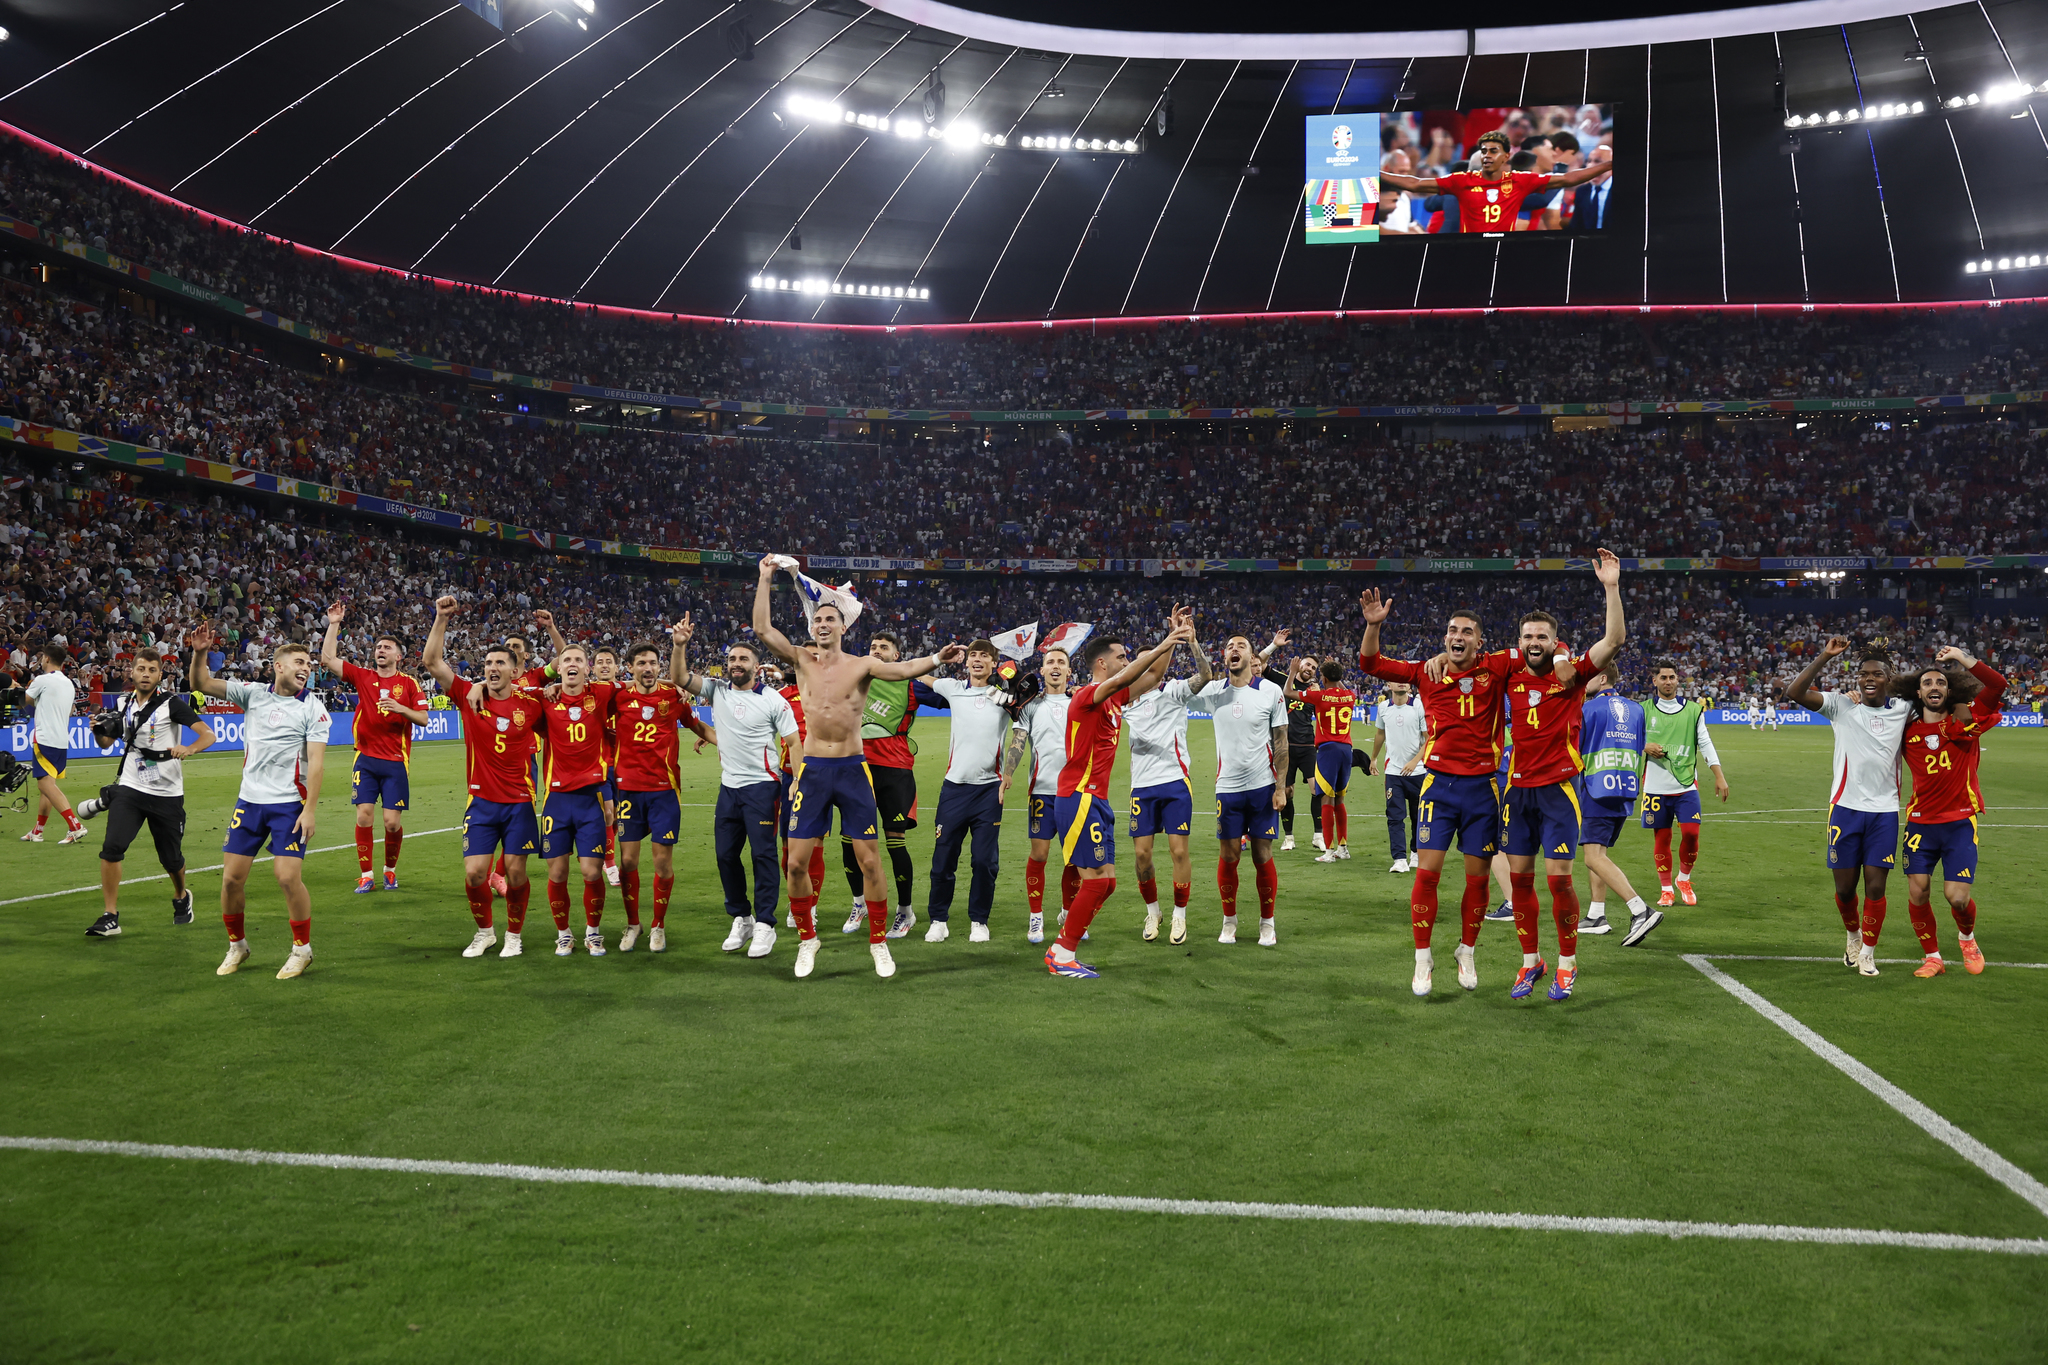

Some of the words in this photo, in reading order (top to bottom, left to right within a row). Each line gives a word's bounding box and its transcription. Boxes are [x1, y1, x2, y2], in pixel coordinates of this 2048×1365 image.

[1482, 204, 1501, 223] 19
[1831, 400, 1876, 408] MUNICH
[1456, 694, 1475, 717] 11
[1325, 706, 1353, 735] 19
[1526, 707, 1540, 729] 4
[494, 733, 507, 753] 5
[566, 722, 587, 743] 10
[633, 722, 658, 743] 22
[1924, 750, 1952, 774] 24
[792, 790, 804, 812] 8
[1030, 798, 1045, 818] 12
[1418, 800, 1434, 823] 11
[1643, 796, 1661, 812] 26
[230, 808, 245, 829] 5
[1502, 803, 1510, 827] 4
[1090, 822, 1103, 843] 6
